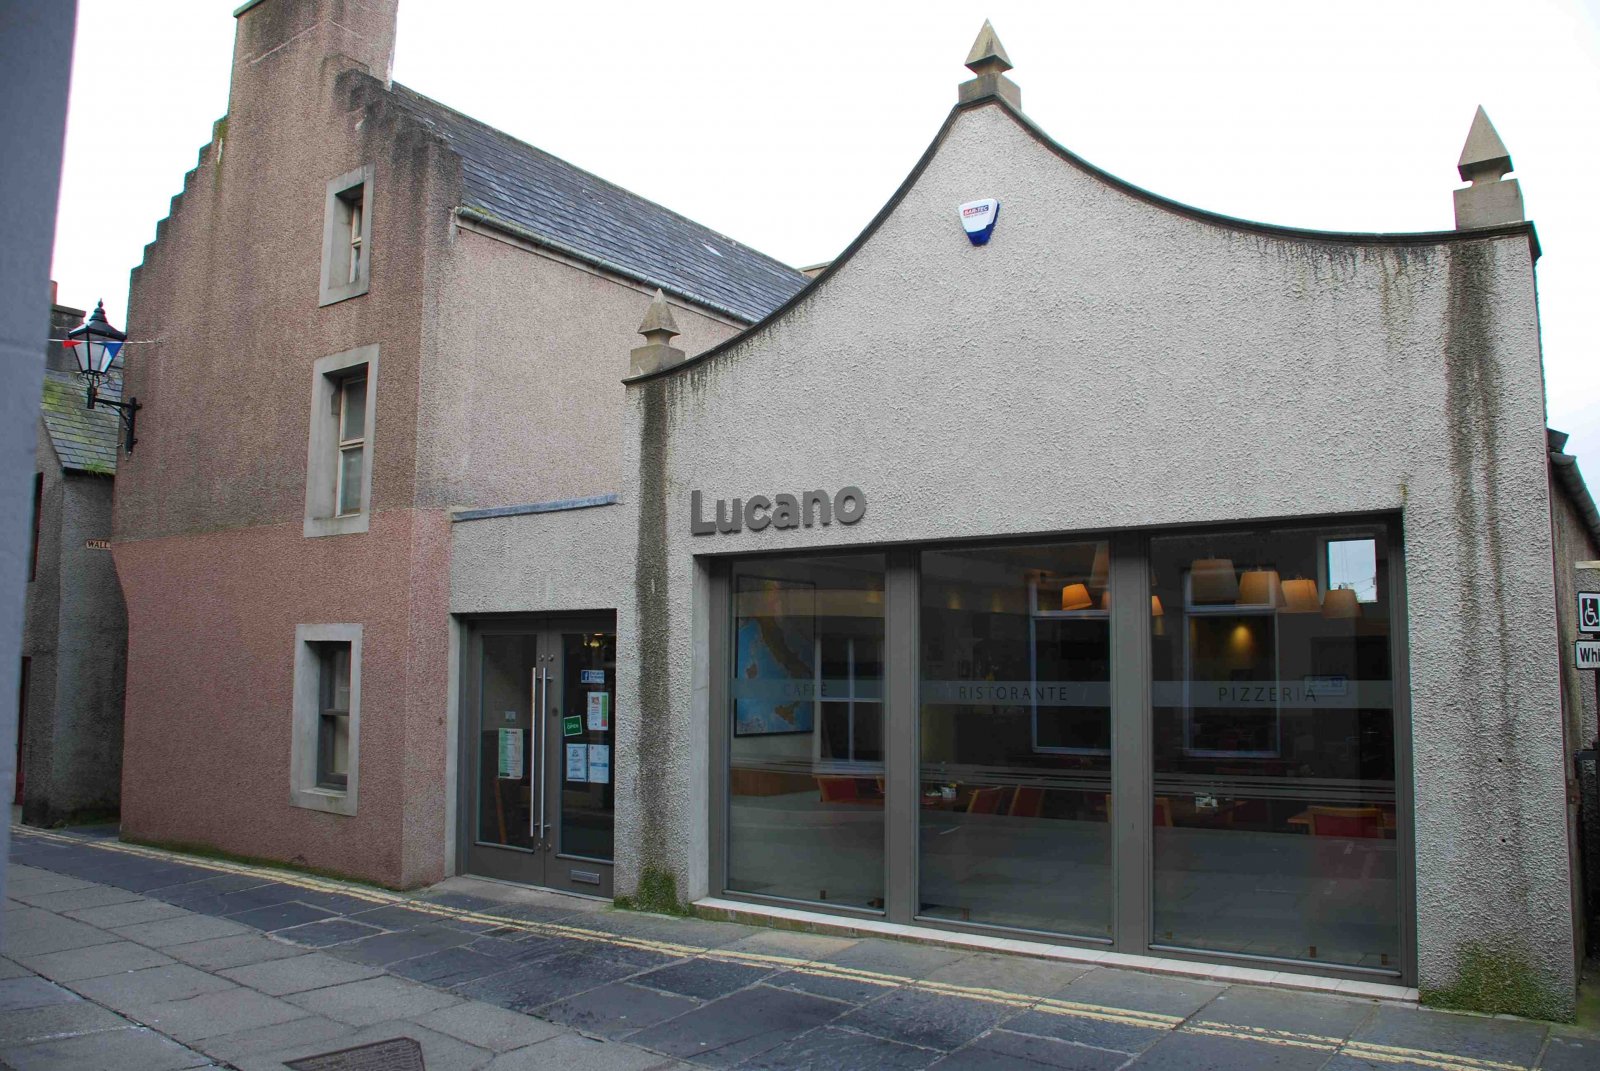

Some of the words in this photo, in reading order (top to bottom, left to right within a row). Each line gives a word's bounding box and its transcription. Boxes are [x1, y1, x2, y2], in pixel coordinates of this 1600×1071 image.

[690, 486, 867, 536] Lucano
[960, 686, 1068, 701] RISTORANTE
[1218, 687, 1317, 702] PIZZERIA
